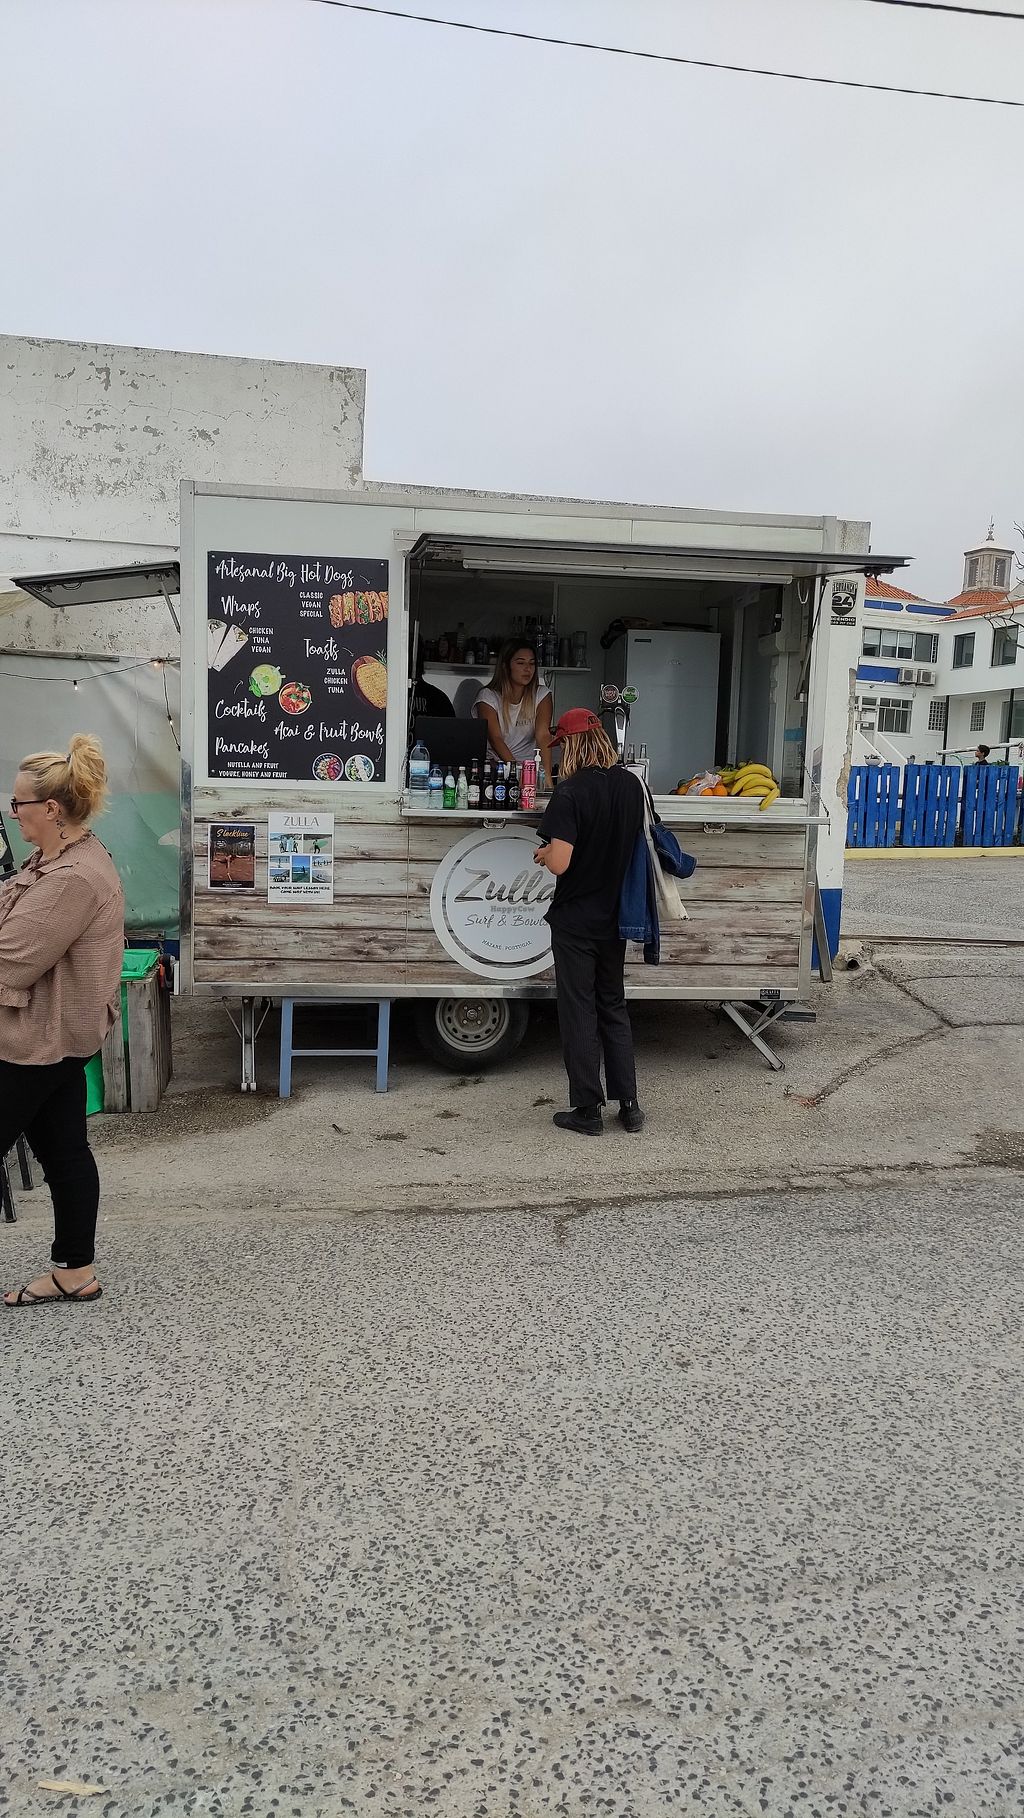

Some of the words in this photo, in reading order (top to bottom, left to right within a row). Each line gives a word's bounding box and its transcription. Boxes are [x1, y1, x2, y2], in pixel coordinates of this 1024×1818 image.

[215, 558, 274, 582] Artesanal
[276, 562, 297, 587] Big
[300, 562, 322, 583] Hot
[324, 565, 355, 589] Dogs
[299, 592, 324, 600] CLASSIC
[832, 595, 852, 606] 24
[221, 596, 261, 618] Wraps
[299, 610, 323, 618] SPECIAL
[249, 627, 274, 635] CHICKEN
[252, 636, 270, 644] TUNA
[304, 637, 339, 661] Toasts
[326, 668, 346, 676] ZULLA
[324, 677, 348, 685] CHICKEN
[327, 686, 344, 694] TUNA
[215, 697, 268, 723] Cocktails
[304, 724, 315, 741] &
[319, 720, 348, 740] Fruit
[350, 722, 385, 745] Bowls
[215, 736, 269, 759] Pancakes
[283, 816, 320, 826] ZULLA
[454, 867, 556, 905] Zulla
[464, 913, 494, 928] Surf
[497, 914, 507, 927] &
